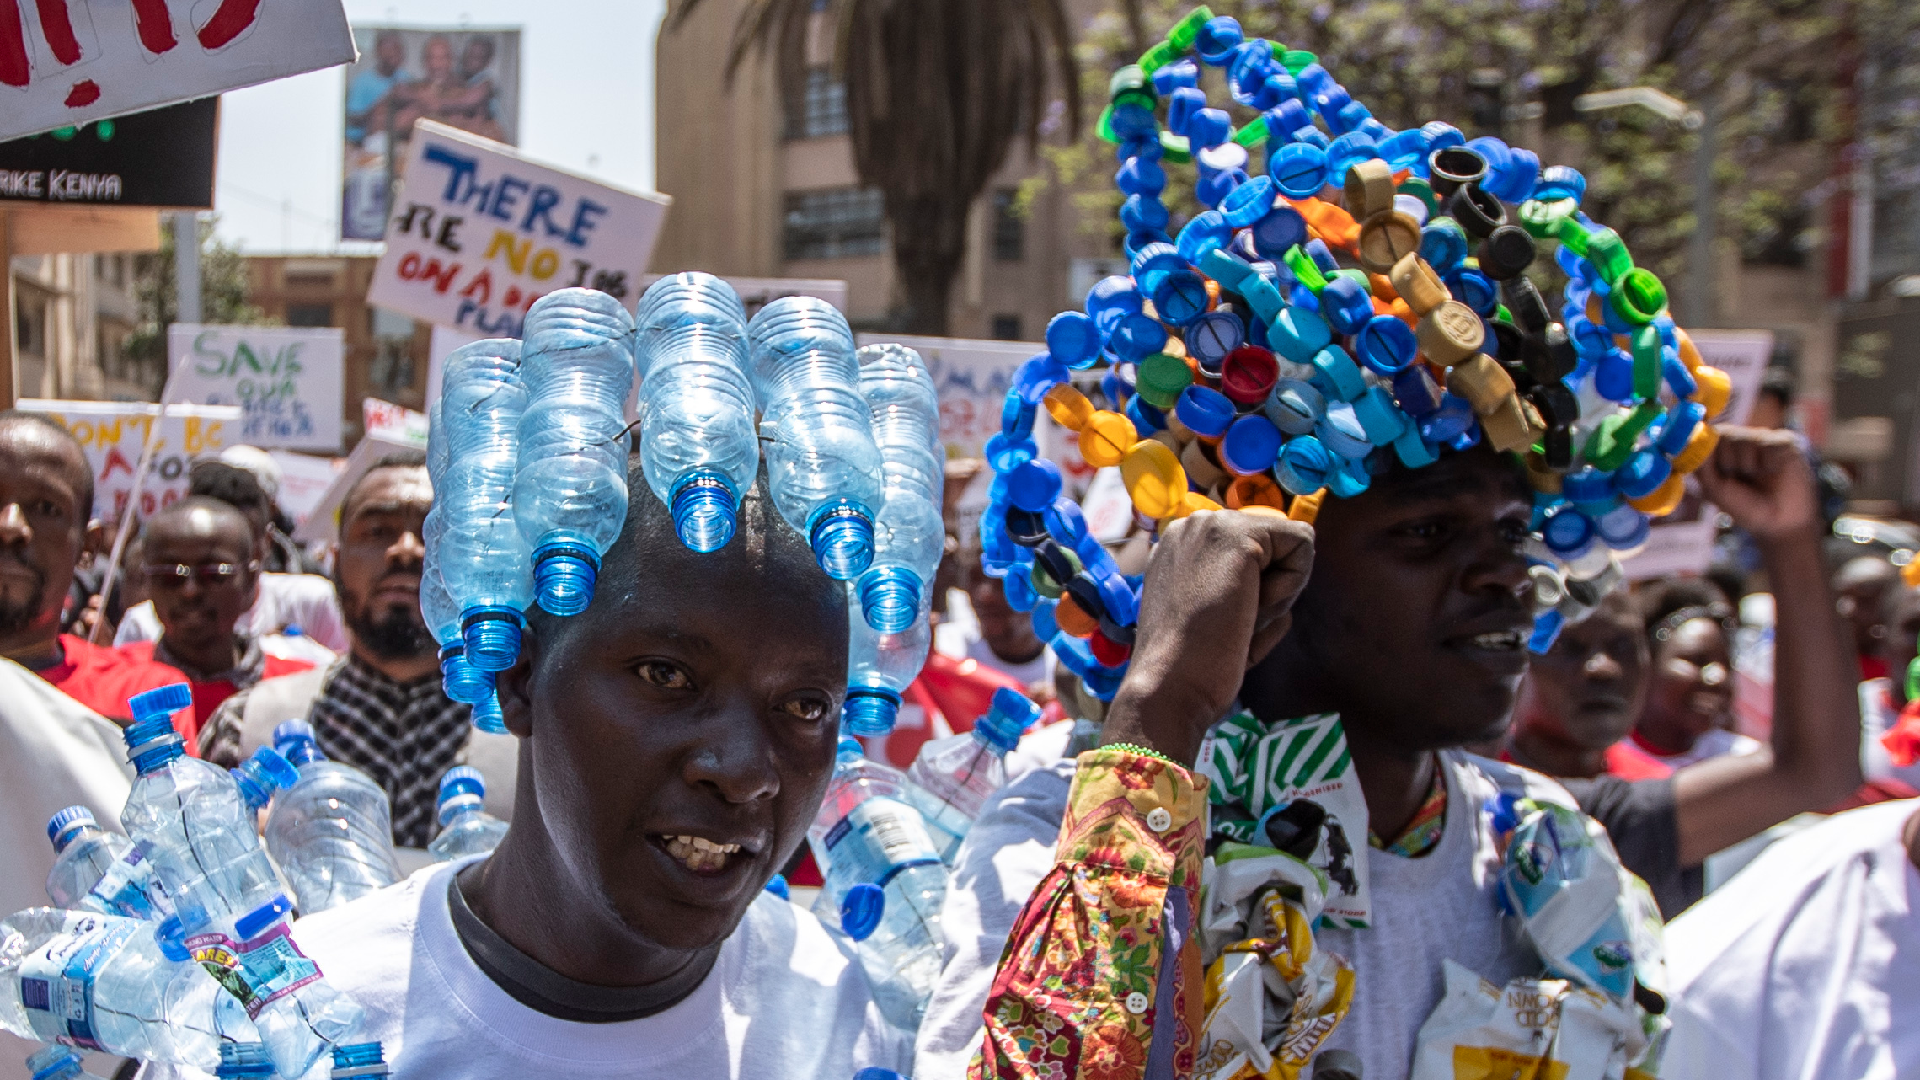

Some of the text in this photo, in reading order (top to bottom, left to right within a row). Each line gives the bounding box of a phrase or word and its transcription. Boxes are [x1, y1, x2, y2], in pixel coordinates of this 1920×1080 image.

[48, 168, 122, 201] KENYA
[421, 141, 608, 248] THERE
[397, 251, 463, 293] ON
[483, 227, 562, 282] NO
[193, 330, 305, 378] SAVE
[100, 448, 134, 481] A
